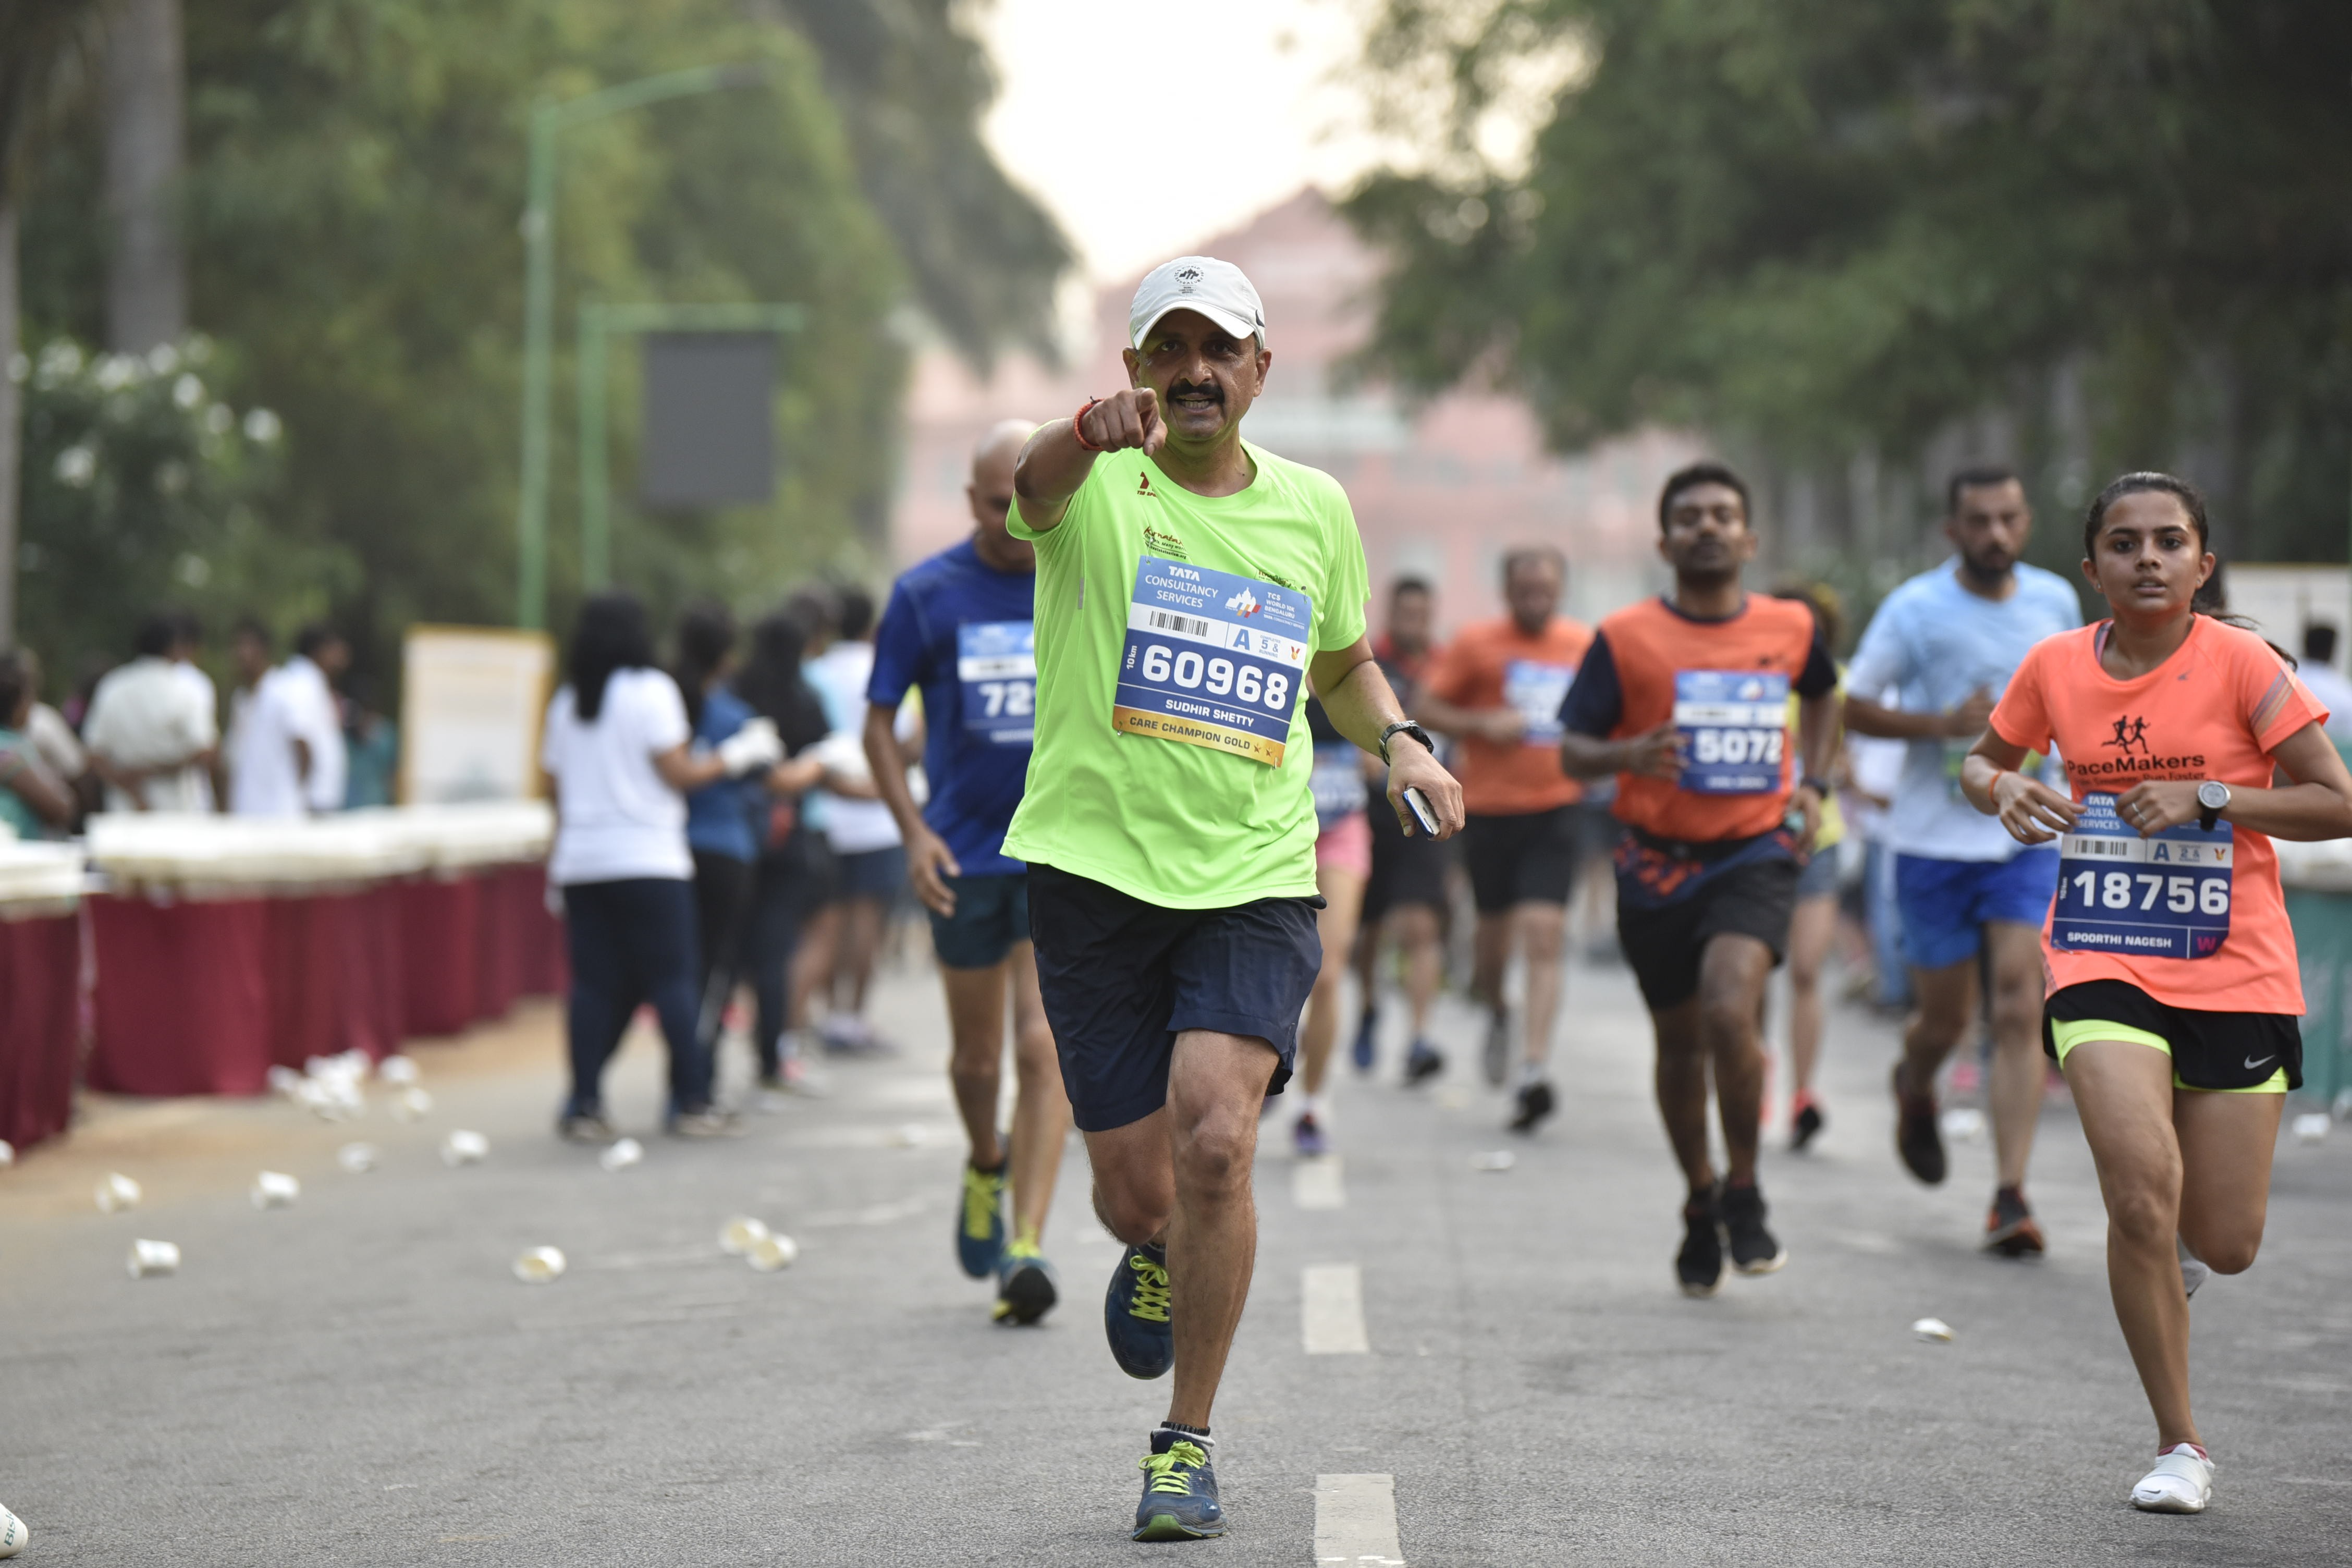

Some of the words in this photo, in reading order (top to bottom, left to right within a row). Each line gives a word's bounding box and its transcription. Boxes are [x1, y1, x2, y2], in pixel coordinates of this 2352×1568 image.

[1161, 542, 1176, 550] Many
[1168, 566, 1200, 581] TATA
[1145, 575, 1219, 598] CONSULTANCY
[1156, 590, 1204, 608] SERVICES
[1267, 592, 1281, 601] TCS
[1264, 605, 1295, 619] BENGALURU
[1266, 599, 1286, 609] WORLD
[1286, 605, 1295, 613] 10K
[1233, 629, 1251, 651] A
[1260, 634, 1281, 644] COMPLETED
[1261, 639, 1268, 650] 5
[1272, 643, 1279, 653] &
[1126, 645, 1137, 670] 10km
[1259, 649, 1279, 658] RUNNING
[1142, 644, 1289, 710] 60968
[977, 680, 1036, 718] 72
[1166, 699, 1210, 717] SUDHIR
[1213, 708, 1254, 727] SHETTY
[1130, 717, 1158, 730] CARE
[1161, 722, 1221, 743] CHAMPION
[1224, 736, 1251, 750] GOLD
[2067, 754, 2204, 775] PaceMakers
[2088, 795, 2115, 806] TATA
[2153, 842, 2171, 862] A
[2073, 870, 2228, 915] 18756
[2067, 932, 2122, 945] SPOORTHI
[2125, 936, 2172, 948] NAGESH
[2197, 936, 2218, 951] W
